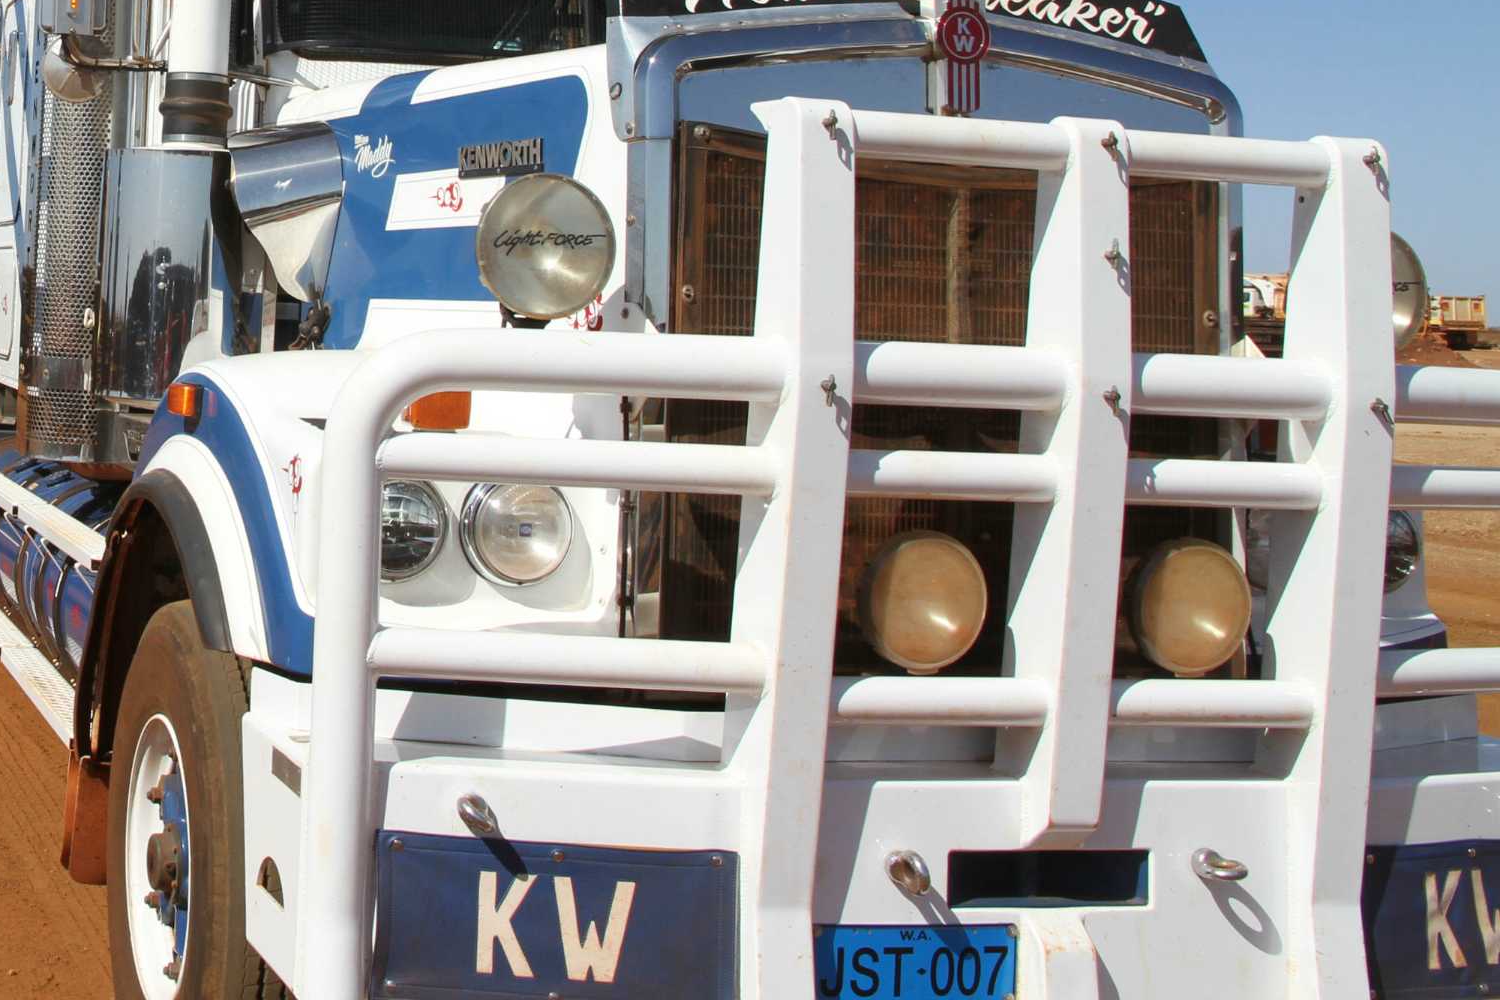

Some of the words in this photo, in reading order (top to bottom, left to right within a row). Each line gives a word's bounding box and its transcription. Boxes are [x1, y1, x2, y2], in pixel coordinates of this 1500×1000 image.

[458, 137, 543, 171] KENWORTH
[476, 870, 637, 983] KW
[900, 929, 932, 941] W.A.
